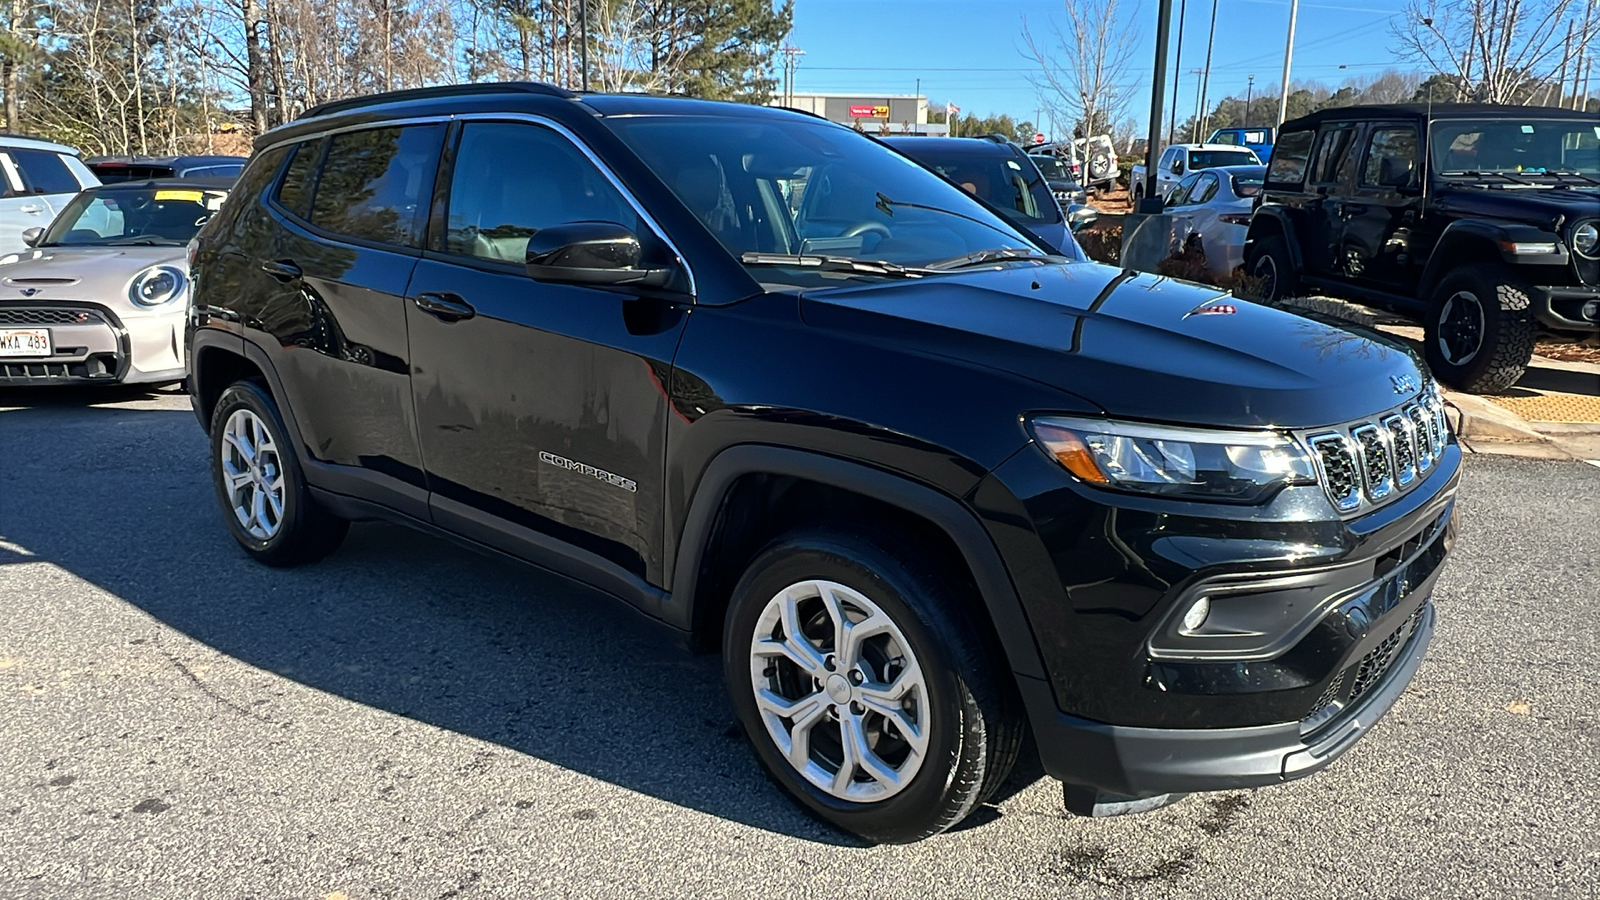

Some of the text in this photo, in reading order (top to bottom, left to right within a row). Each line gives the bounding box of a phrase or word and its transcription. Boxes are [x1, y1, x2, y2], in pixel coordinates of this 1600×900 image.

[0, 335, 47, 349] WXA 483
[539, 451, 637, 493] COMPASS
